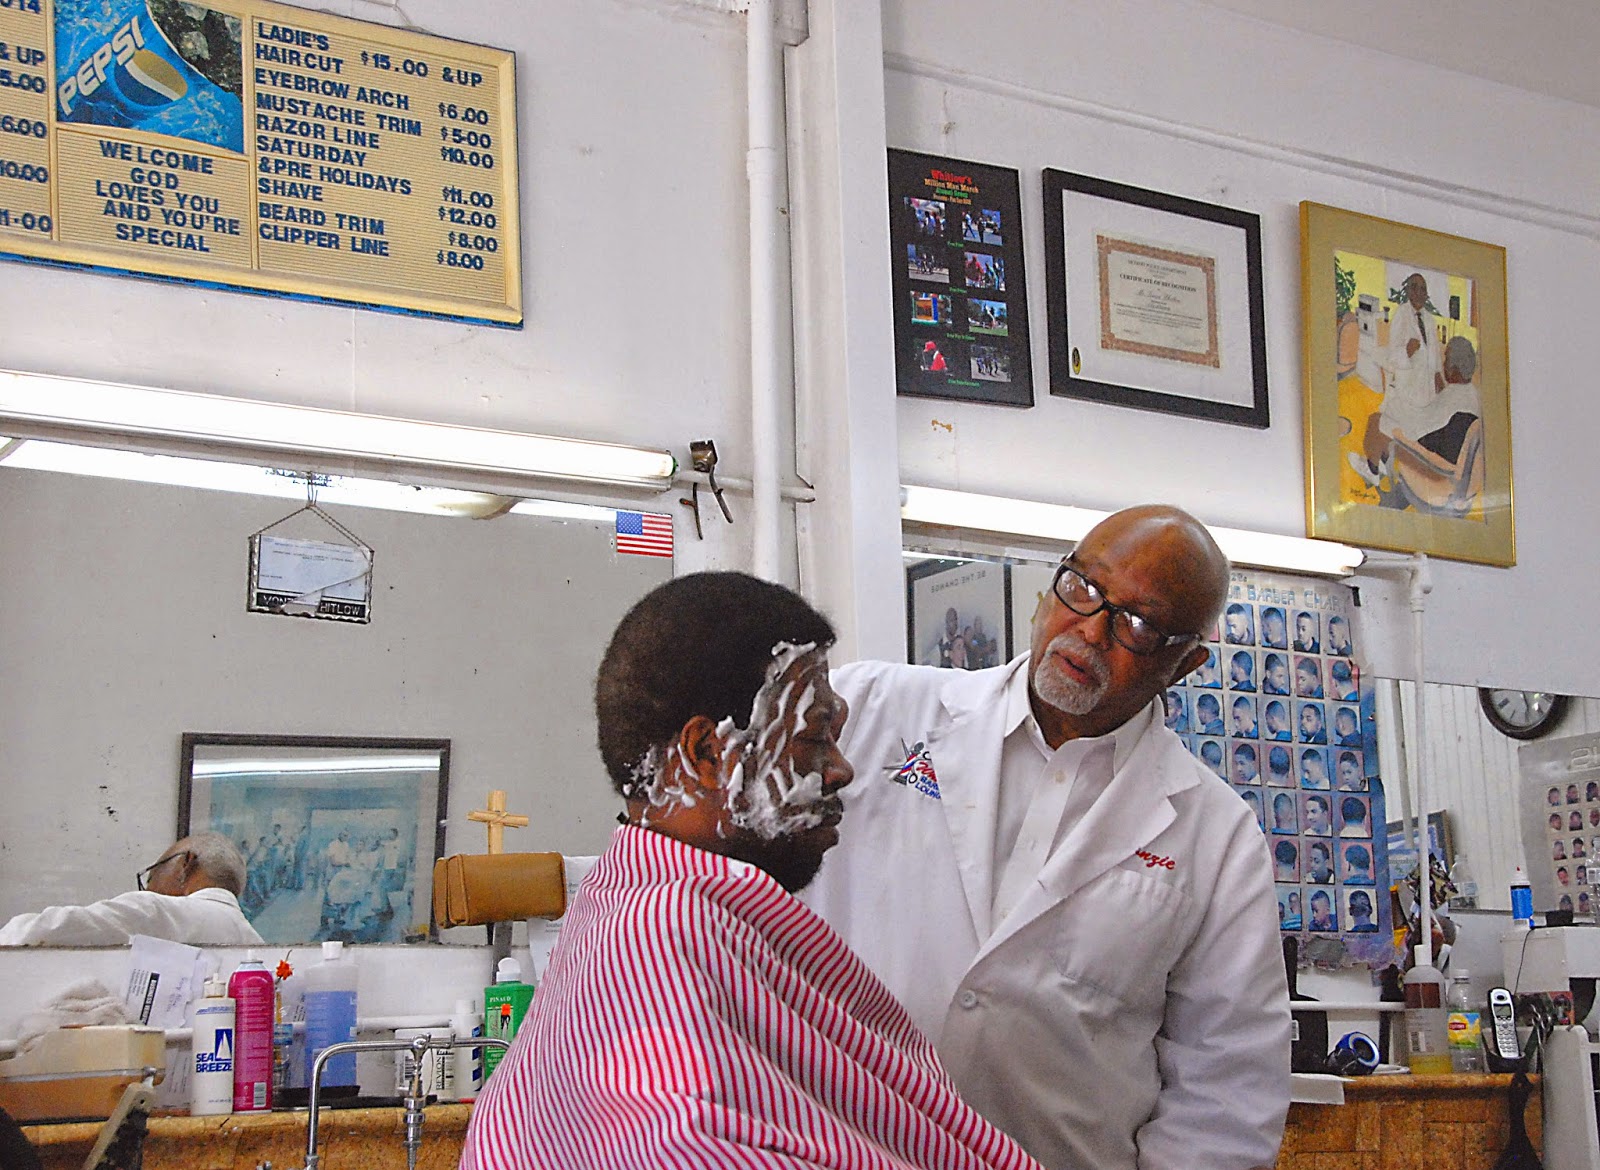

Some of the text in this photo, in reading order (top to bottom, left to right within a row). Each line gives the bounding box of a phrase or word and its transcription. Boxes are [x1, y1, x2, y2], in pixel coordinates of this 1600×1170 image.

[258, 22, 329, 51] LADIE'S
[16, 45, 46, 66] UP
[58, 16, 146, 116] PEPSI
[361, 51, 428, 77] $15.00
[255, 67, 488, 125] EYEBROW ARCH $6.00
[1, 115, 47, 138] 6.00
[256, 92, 365, 126] MUSTACHE
[376, 113, 422, 136] TRIM
[99, 140, 213, 175] WELCOME
[257, 114, 494, 169] RAZOR LINE $10.00
[257, 135, 367, 167] SATURDAY
[130, 168, 179, 189] GOD
[319, 166, 412, 195] HOLIDAYS
[442, 185, 494, 208] $11.00
[96, 180, 219, 214] LOVES YOU
[258, 177, 496, 229] SHAVE $12.00
[103, 200, 240, 235] AND YOU'RE
[259, 202, 498, 252] BEARD TRIM $8.00
[116, 223, 210, 252] SPECIAL
[259, 223, 484, 271] CLIPPER LINE $8.00
[196, 1053, 214, 1063] SEA
[196, 1062, 233, 1073] BREEZE
